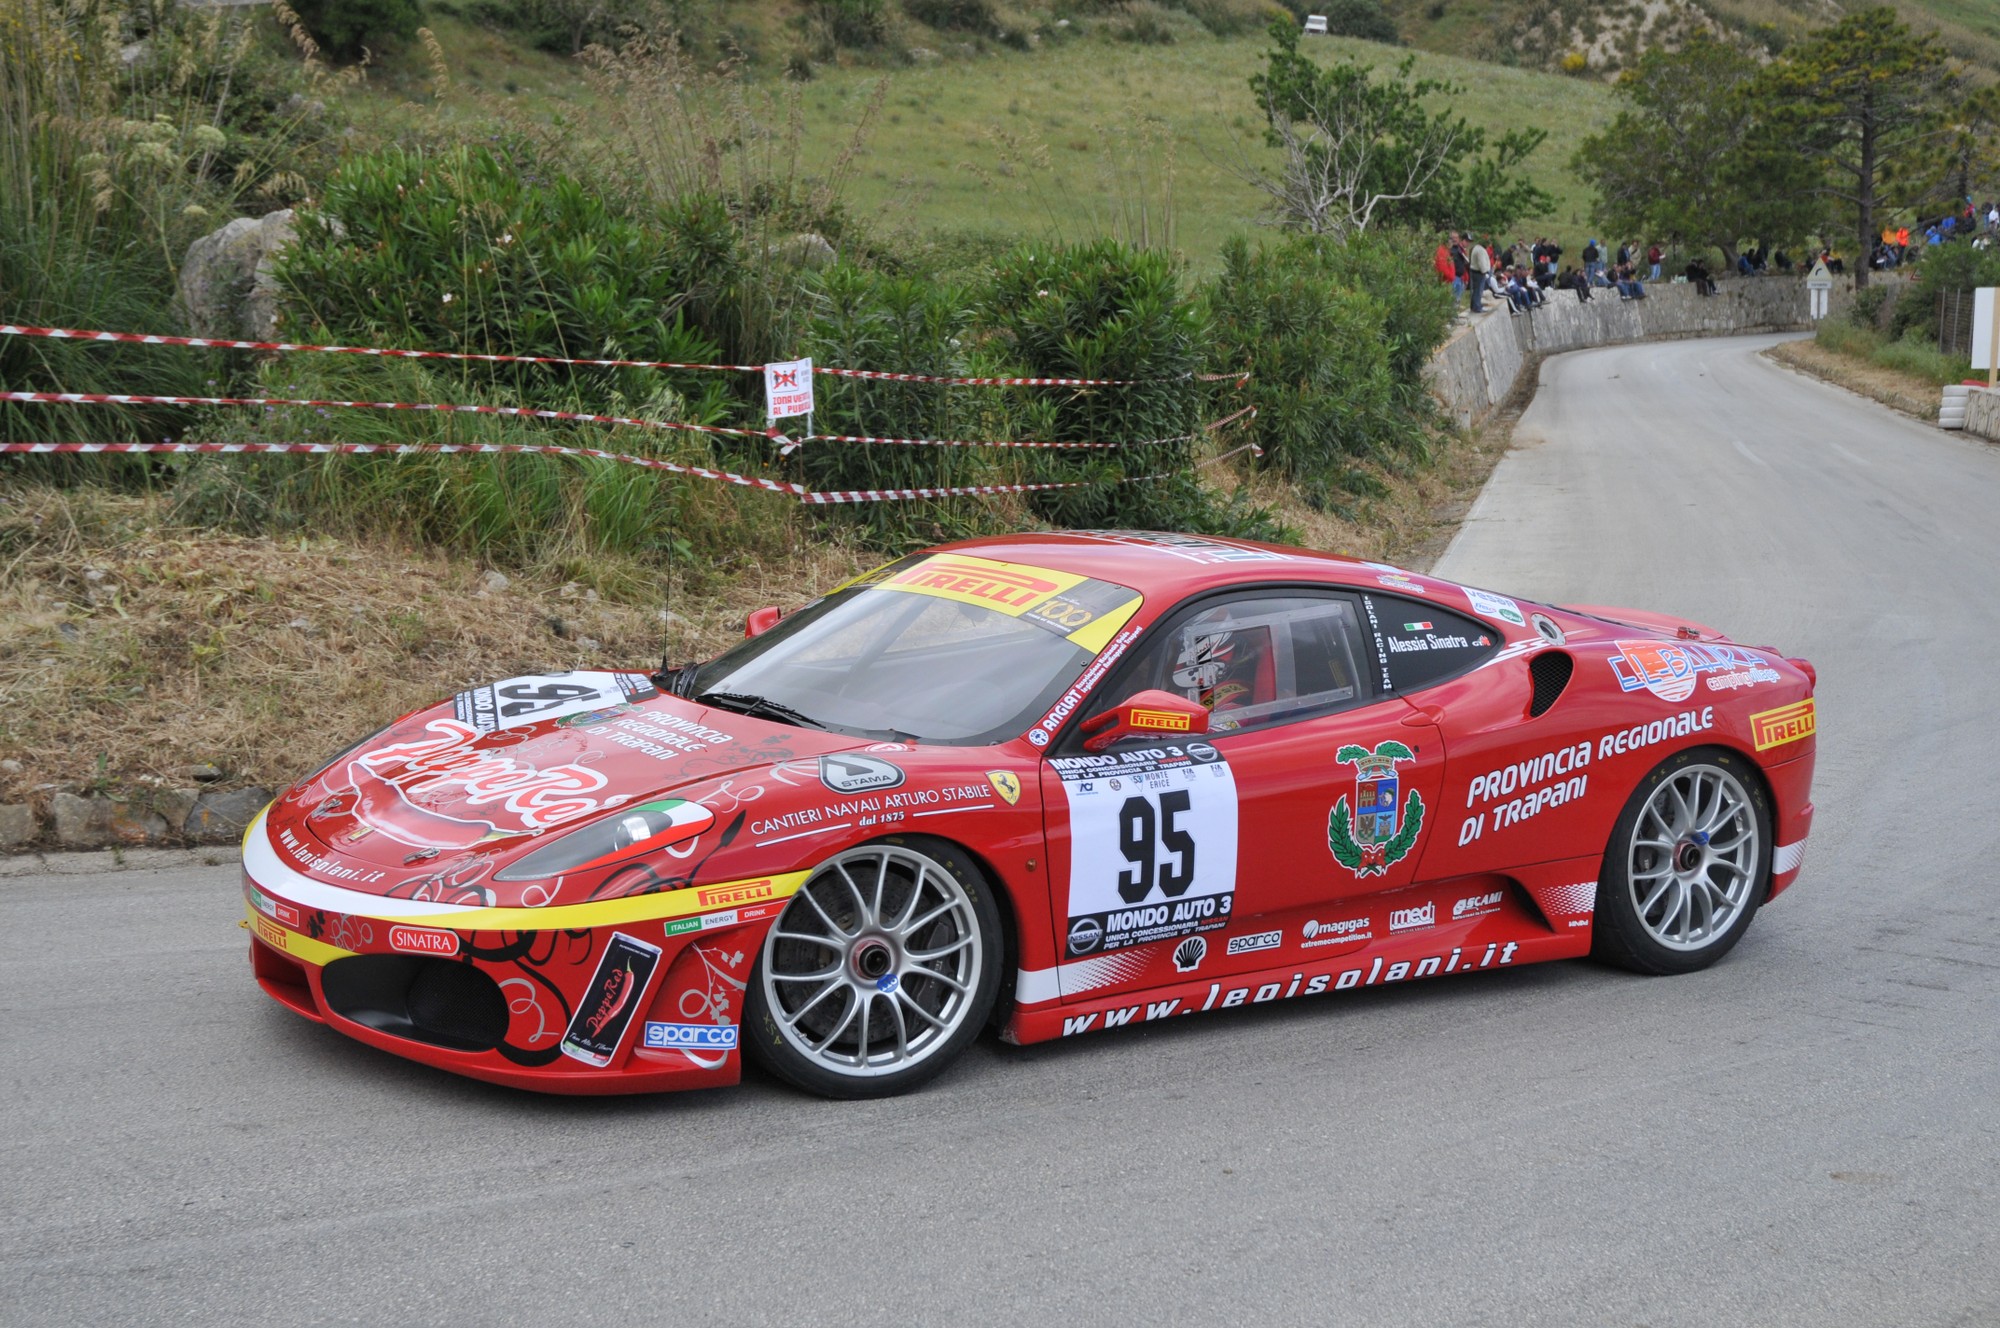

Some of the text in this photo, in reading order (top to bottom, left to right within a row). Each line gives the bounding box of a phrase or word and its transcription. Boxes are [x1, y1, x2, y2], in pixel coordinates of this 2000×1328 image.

[890, 562, 1058, 607] PIRELLI
[1034, 600, 1092, 627] 100
[1374, 632, 1387, 664] RACING
[1388, 633, 1468, 653] Alessia Sinatra
[1381, 667, 1392, 689] TEAM
[585, 726, 612, 735] DI
[1132, 712, 1188, 729] PIRELLI
[1754, 703, 1814, 746] PIRELLI
[1049, 746, 1184, 770] MONDO AUTO 3
[1058, 768, 1086, 776] UNICA
[1086, 760, 1158, 773] CONCESSIONARIA
[1100, 768, 1142, 777] PROVINCIA
[1146, 764, 1155, 772] DI
[1159, 760, 1192, 770] TRAPANI
[841, 775, 892, 788] STAMA
[1145, 771, 1168, 780] MONTE
[1150, 779, 1170, 788] ERICE
[751, 784, 992, 835] CANTIERI NAVALI ARTURO STABILE
[859, 811, 905, 826] dal 1875
[1458, 813, 1484, 847] DI
[1118, 789, 1196, 904] 95
[698, 880, 772, 906] PIRELLI
[671, 908, 766, 932] ITALIAN ENERGY DRINK
[1106, 895, 1232, 933] MONDO AUTO 3
[257, 916, 287, 949] PIRELLI
[1069, 931, 1100, 942] NISSAN
[1104, 942, 1120, 950] PER
[1138, 931, 1178, 943] PROVINCIA
[1195, 922, 1226, 933] TRAPANI
[1106, 932, 1130, 942] UNICA
[1132, 920, 1198, 938] CONCESSIONARIA
[1318, 917, 1370, 935] magigas
[396, 931, 451, 950] SINATRA
[1229, 932, 1280, 952] sparco
[1300, 932, 1372, 949] extremecompetition.it
[1062, 942, 1519, 1037] www.leoisolani.it
[648, 1024, 736, 1048] sparco
